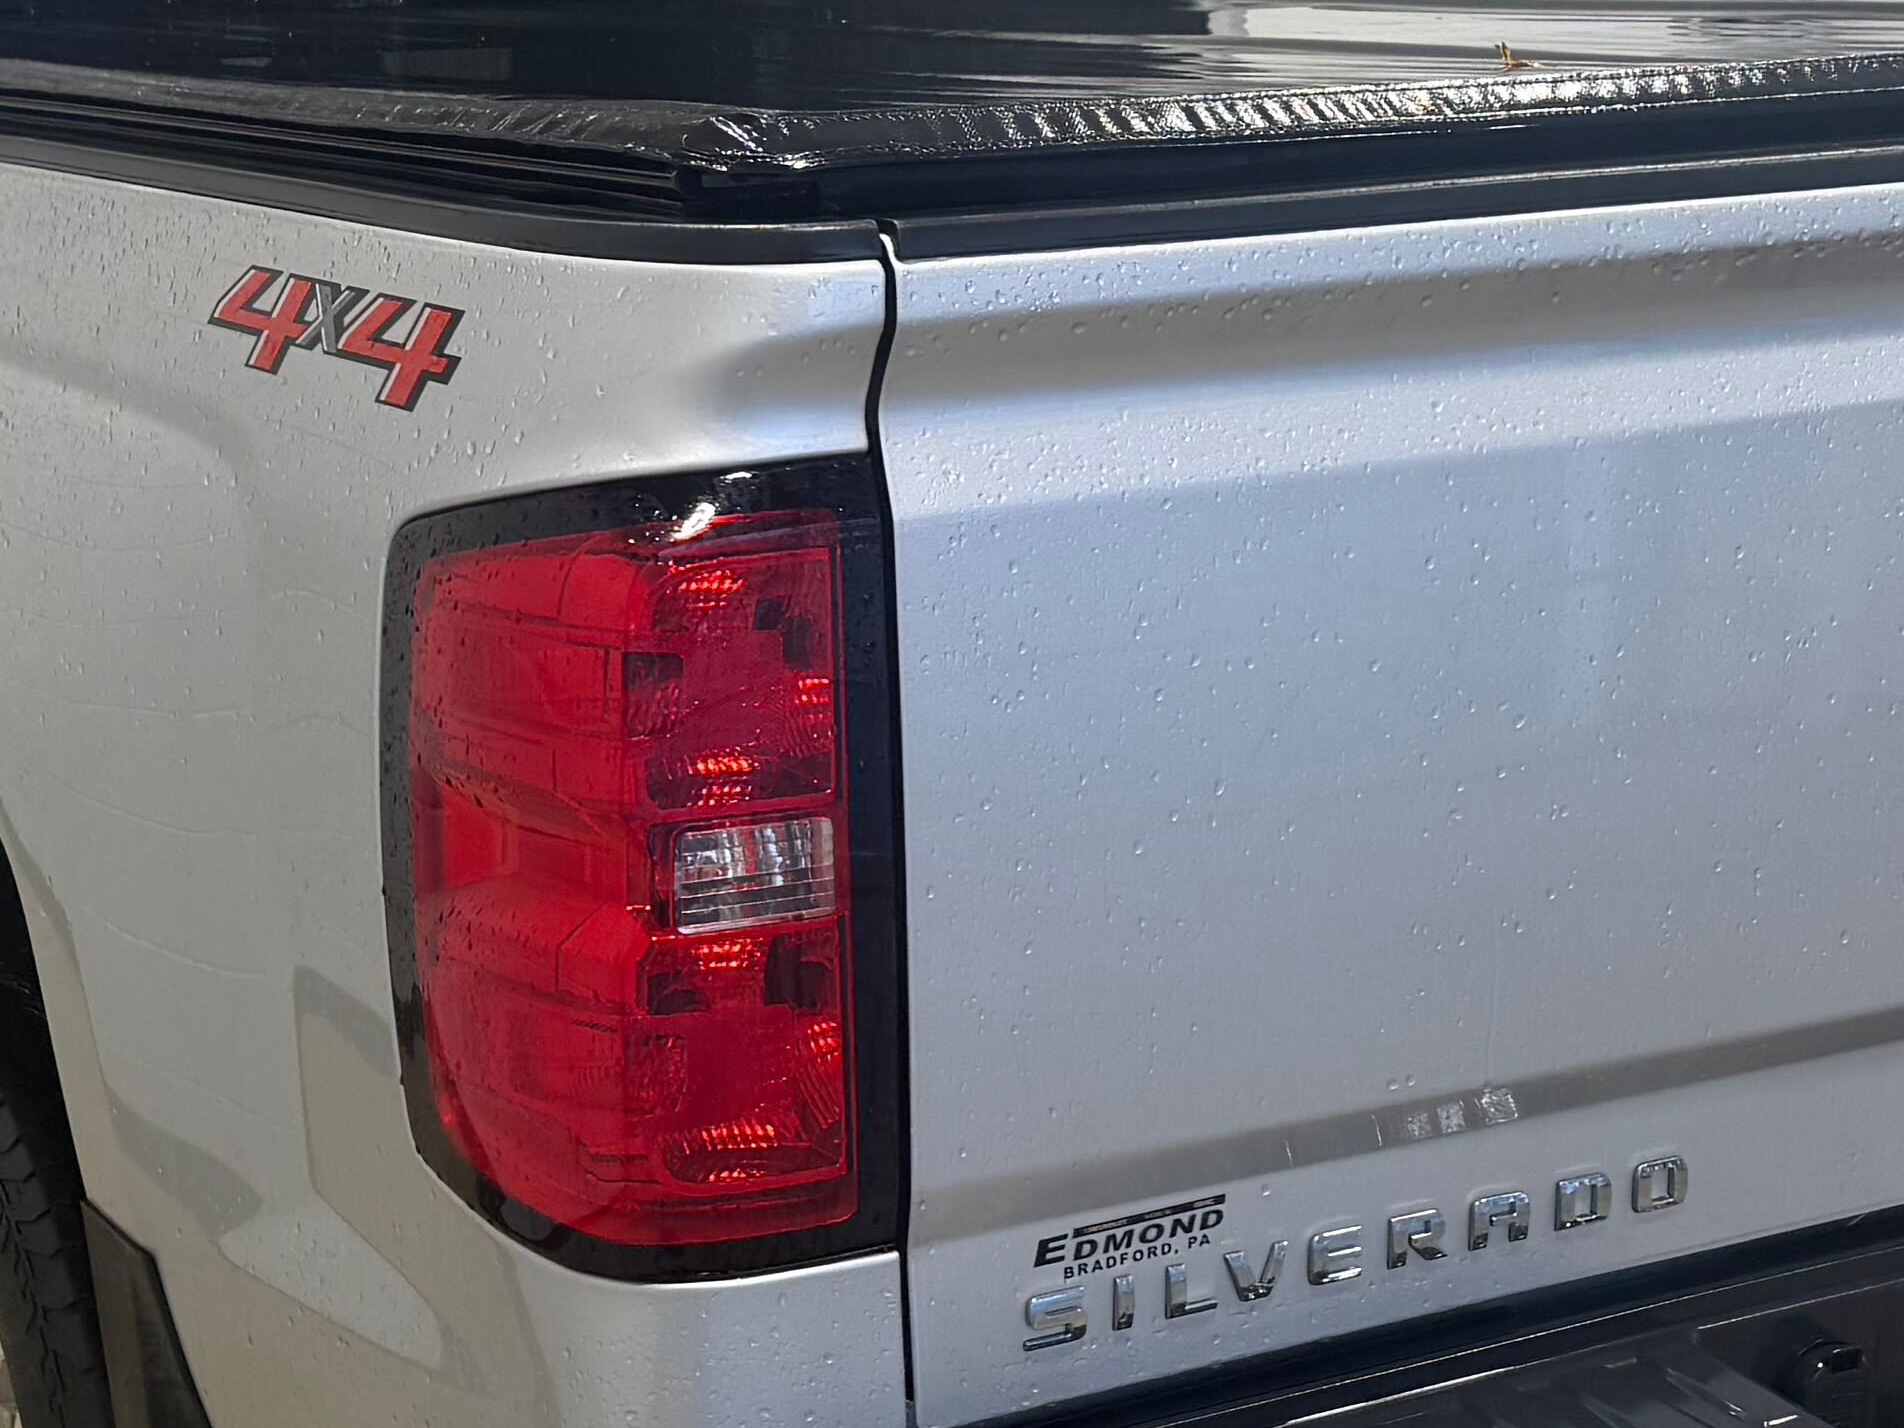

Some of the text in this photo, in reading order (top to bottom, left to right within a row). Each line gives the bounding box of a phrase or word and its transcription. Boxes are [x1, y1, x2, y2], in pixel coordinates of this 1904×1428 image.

[1022, 1154, 1689, 1353] SILVERADO
[1033, 1208, 1225, 1268] EDMOND
[1063, 1233, 1211, 1280] BRADFORD, PA
